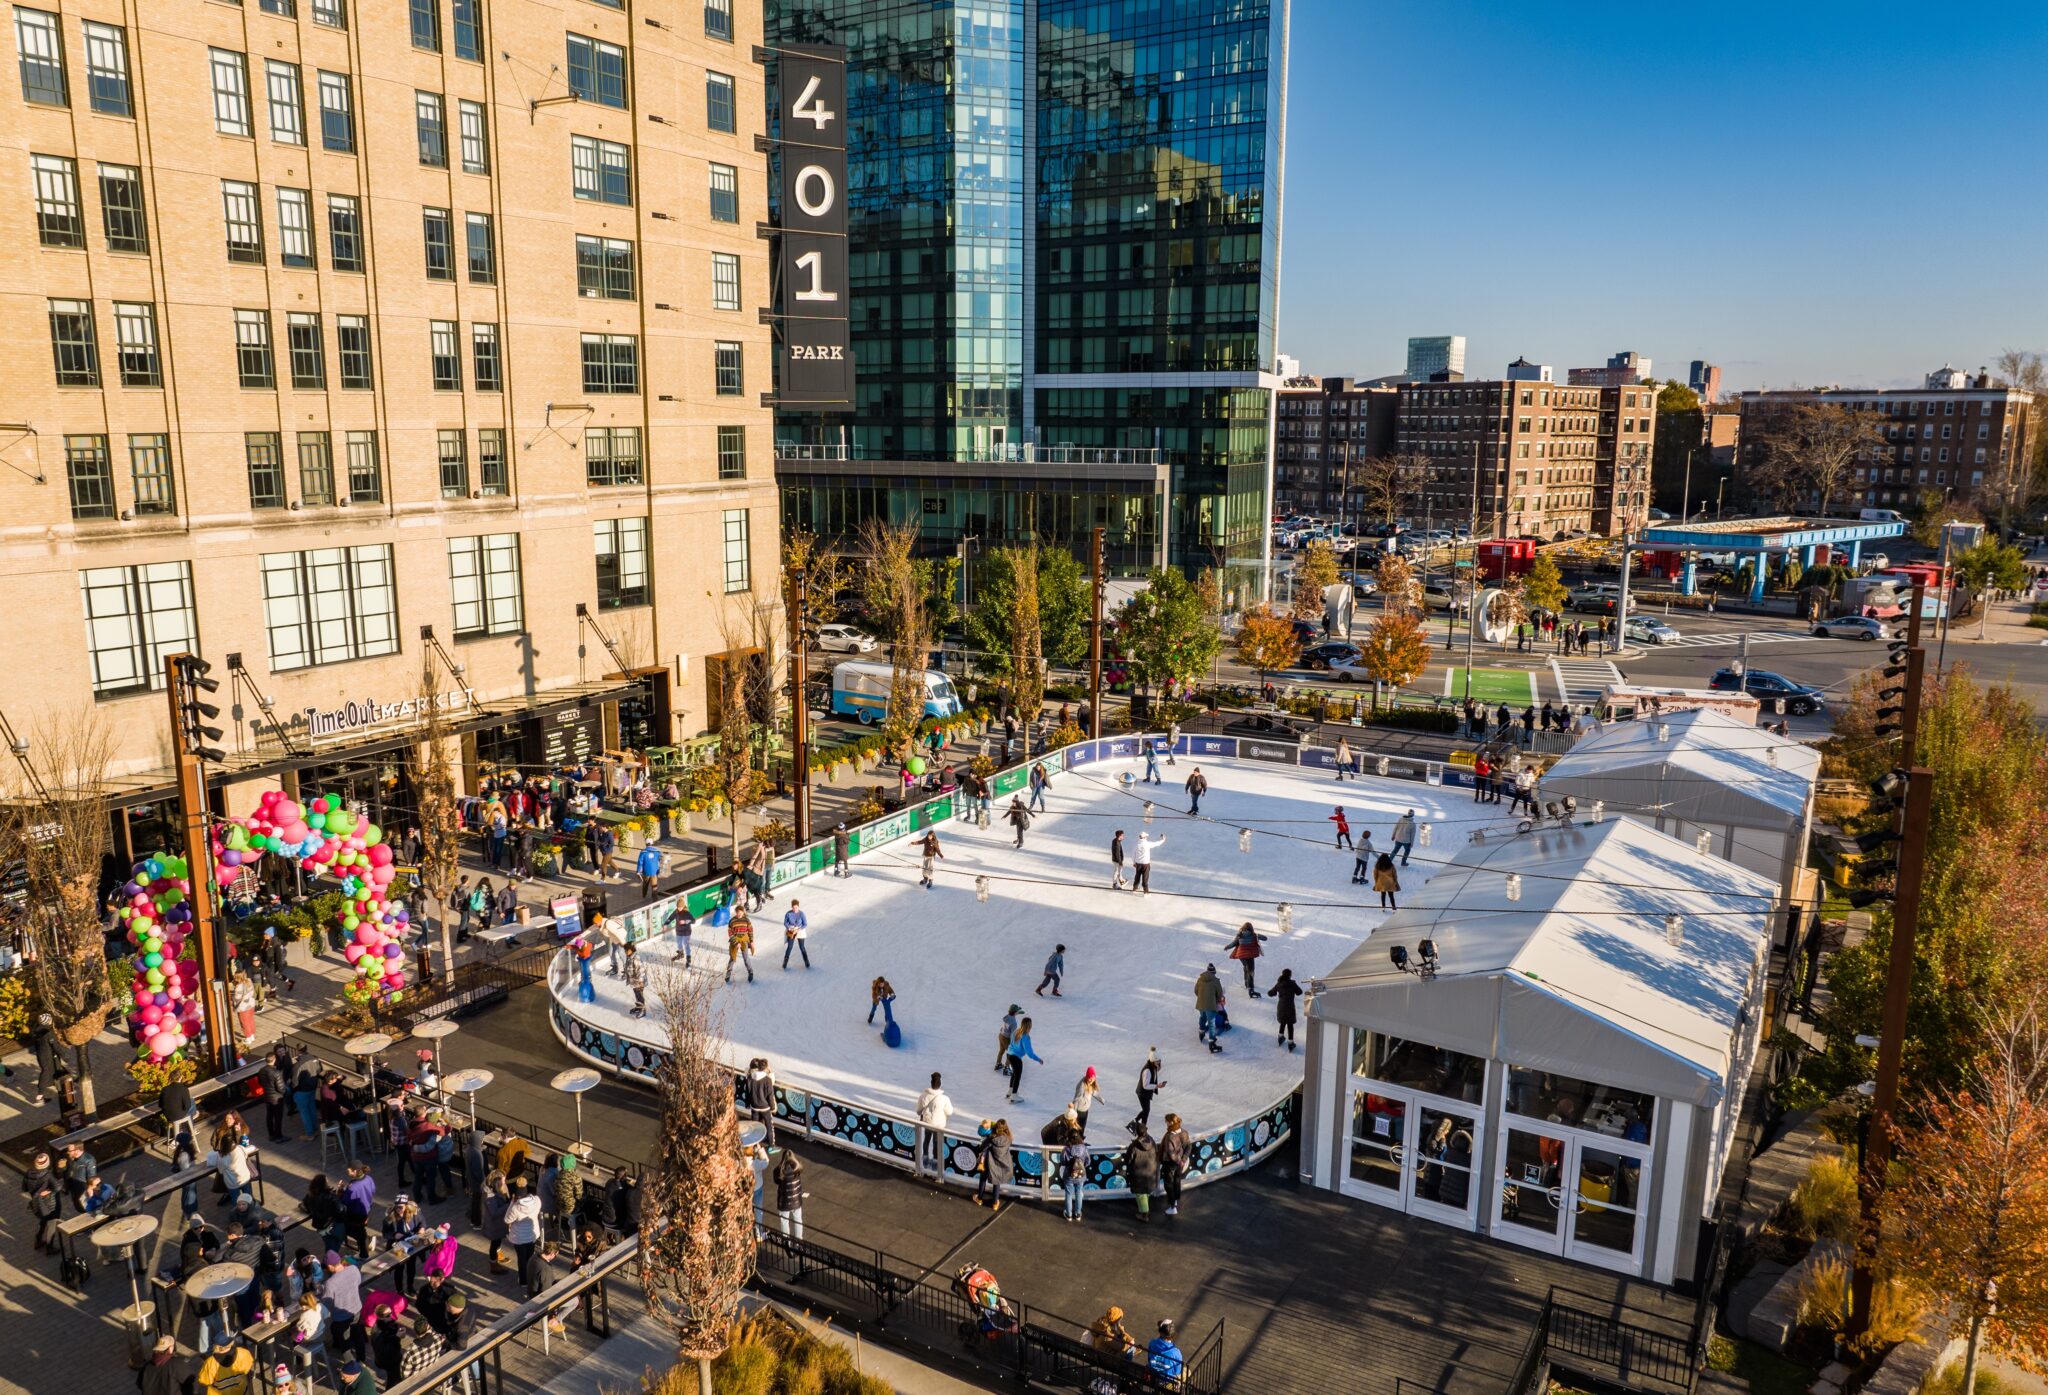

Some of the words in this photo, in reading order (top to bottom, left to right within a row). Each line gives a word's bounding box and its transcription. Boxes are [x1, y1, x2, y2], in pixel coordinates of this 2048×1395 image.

[790, 345, 844, 360] PARK
[924, 501, 943, 511] CB2
[381, 687, 475, 720] MARKET
[1111, 743, 1125, 751] BEVY
[1321, 755, 1337, 764] BEVY
[1459, 773, 1475, 782] BEVY
